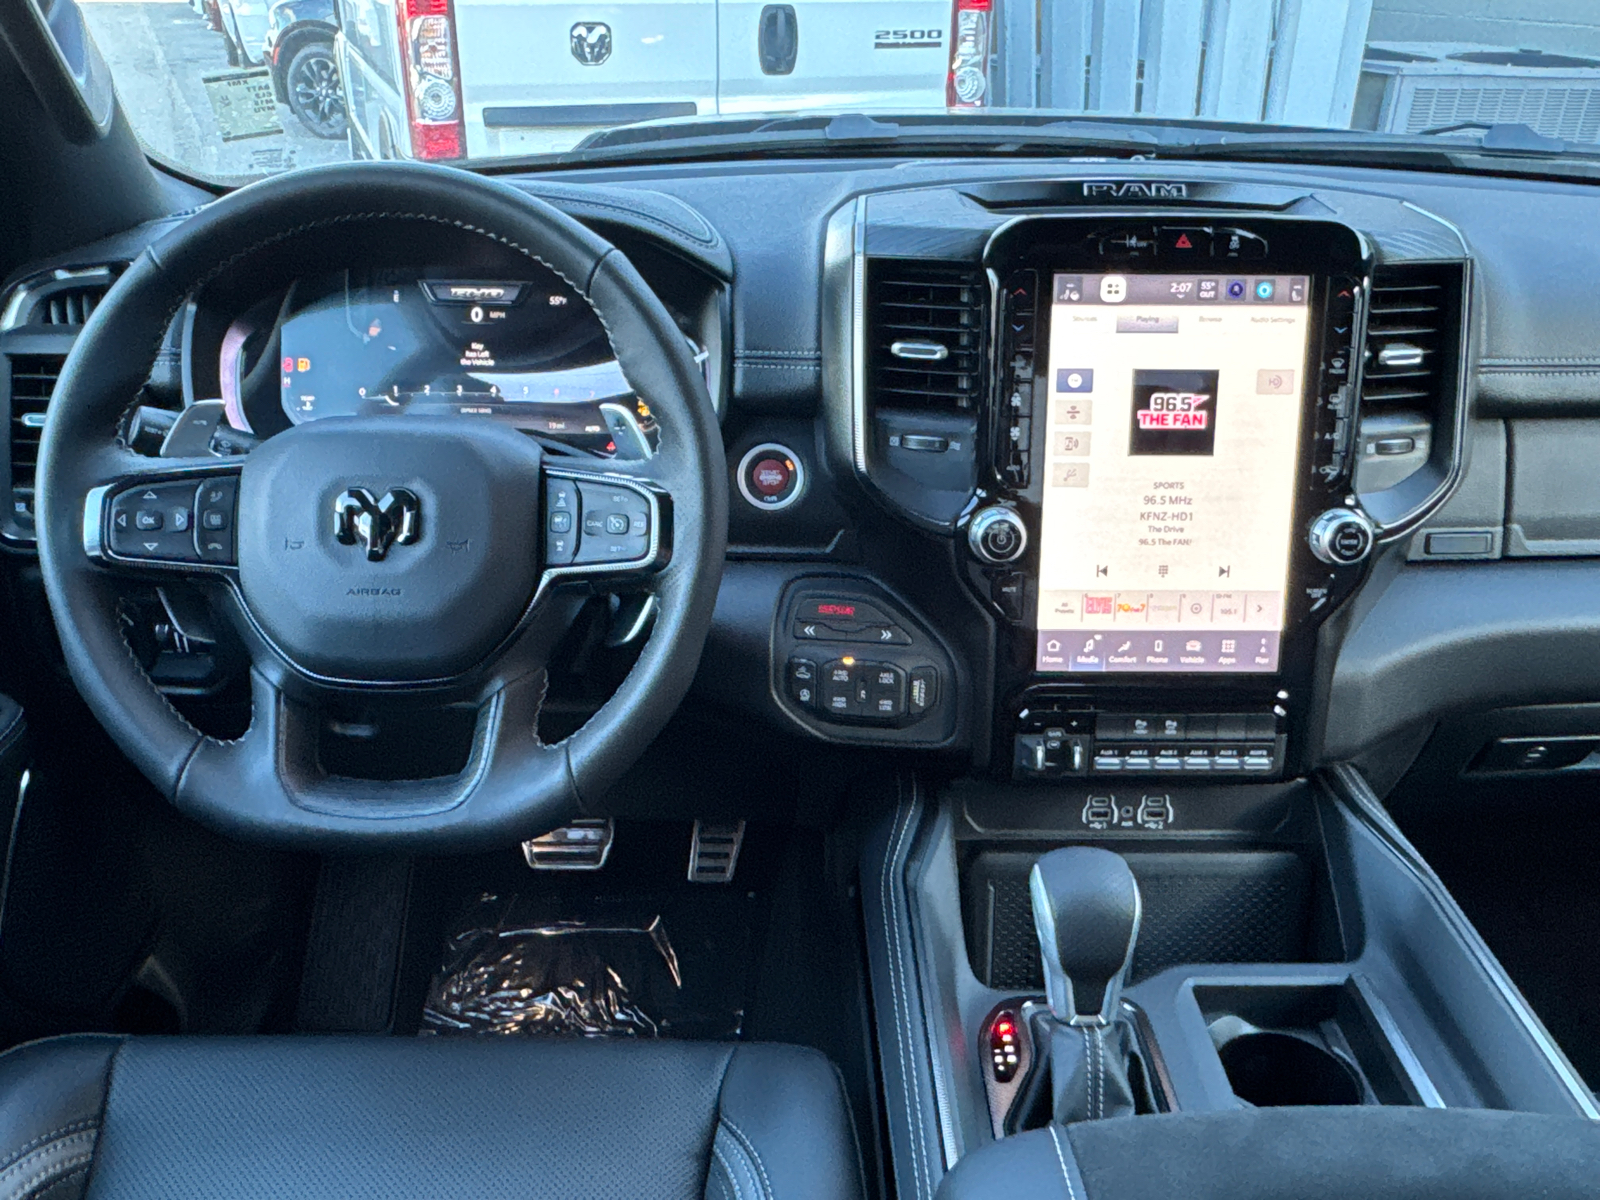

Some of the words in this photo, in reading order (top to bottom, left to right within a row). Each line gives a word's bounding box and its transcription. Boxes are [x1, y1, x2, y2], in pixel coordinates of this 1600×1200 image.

[875, 30, 942, 39] 2500
[1083, 183, 1186, 197] RAM
[1170, 283, 1193, 292] 2:07
[1201, 281, 1215, 290] 55°
[549, 296, 567, 305] 55°F
[470, 306, 483, 322] 0
[489, 310, 506, 319] MPH
[1136, 315, 1160, 324] Playing
[471, 342, 484, 351] Key
[472, 358, 495, 367] Vehicle
[284, 377, 291, 385] H
[358, 387, 366, 396] 0
[424, 384, 431, 393] 2
[456, 384, 463, 393] 3
[490, 385, 497, 393] 4
[523, 386, 529, 395] 5
[1153, 396, 1192, 412] 96.5
[1140, 413, 1170, 426] THE
[1173, 413, 1203, 426] FAN
[1153, 481, 1185, 490] SPORTS
[1143, 495, 1167, 505] 96.5
[1168, 495, 1193, 505] MHz
[142, 516, 155, 525] OK
[1139, 511, 1194, 521] KFNZ-HD1
[1148, 525, 1162, 533] The
[1163, 525, 1185, 533] Drive
[1138, 538, 1156, 546] 96.5
[1158, 538, 1172, 546] The
[346, 587, 401, 596] AIRBAG
[1109, 656, 1137, 664] Comfort
[1146, 656, 1169, 664] Phone
[1218, 657, 1236, 665] Apps
